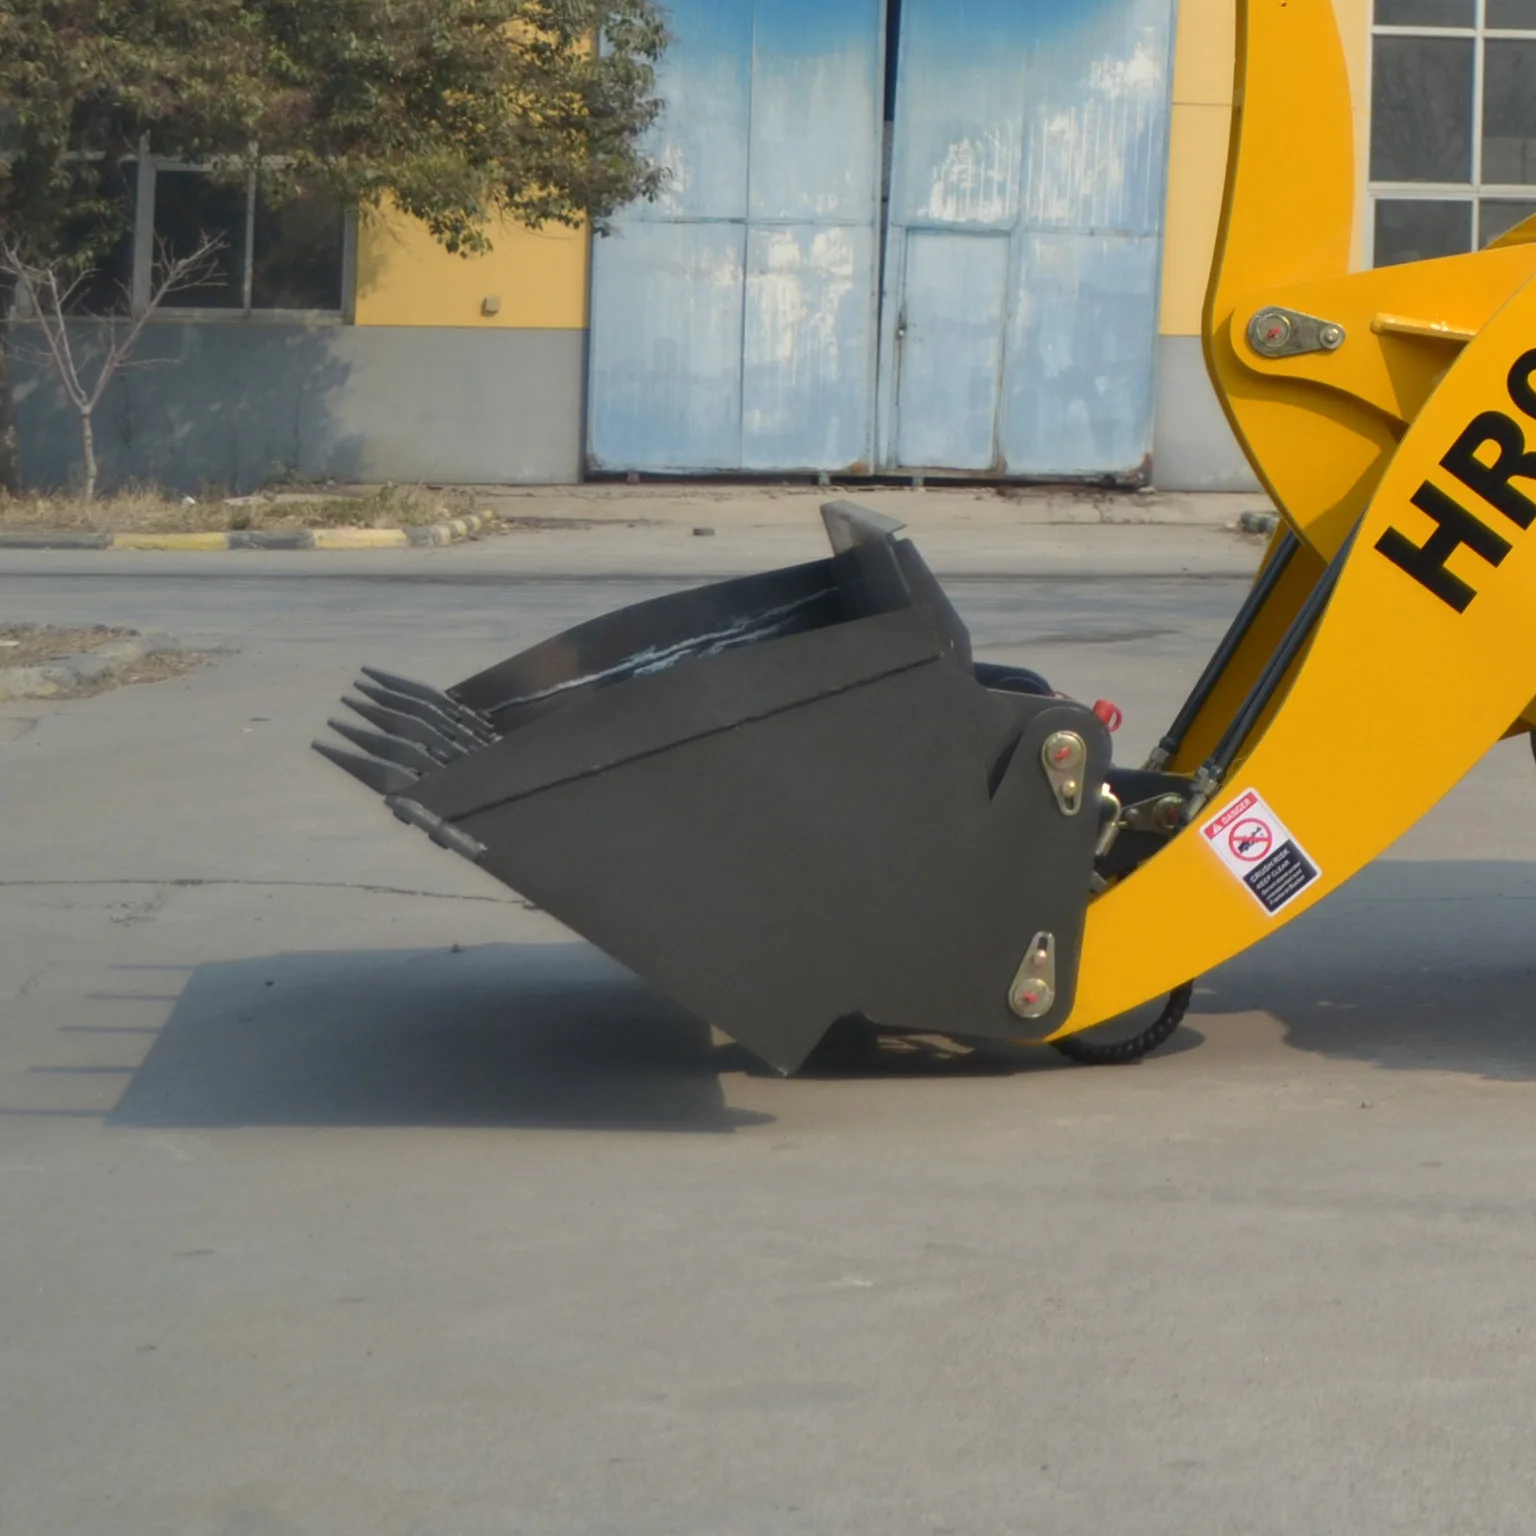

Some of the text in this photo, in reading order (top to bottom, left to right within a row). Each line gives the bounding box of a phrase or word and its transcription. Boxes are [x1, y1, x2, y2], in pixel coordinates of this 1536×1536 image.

[1221, 798, 1251, 824] DANGER
[1250, 847, 1290, 883] CRUSH RISK
[1256, 875, 1271, 889] KEEP
[1271, 859, 1290, 877] CLEAR
